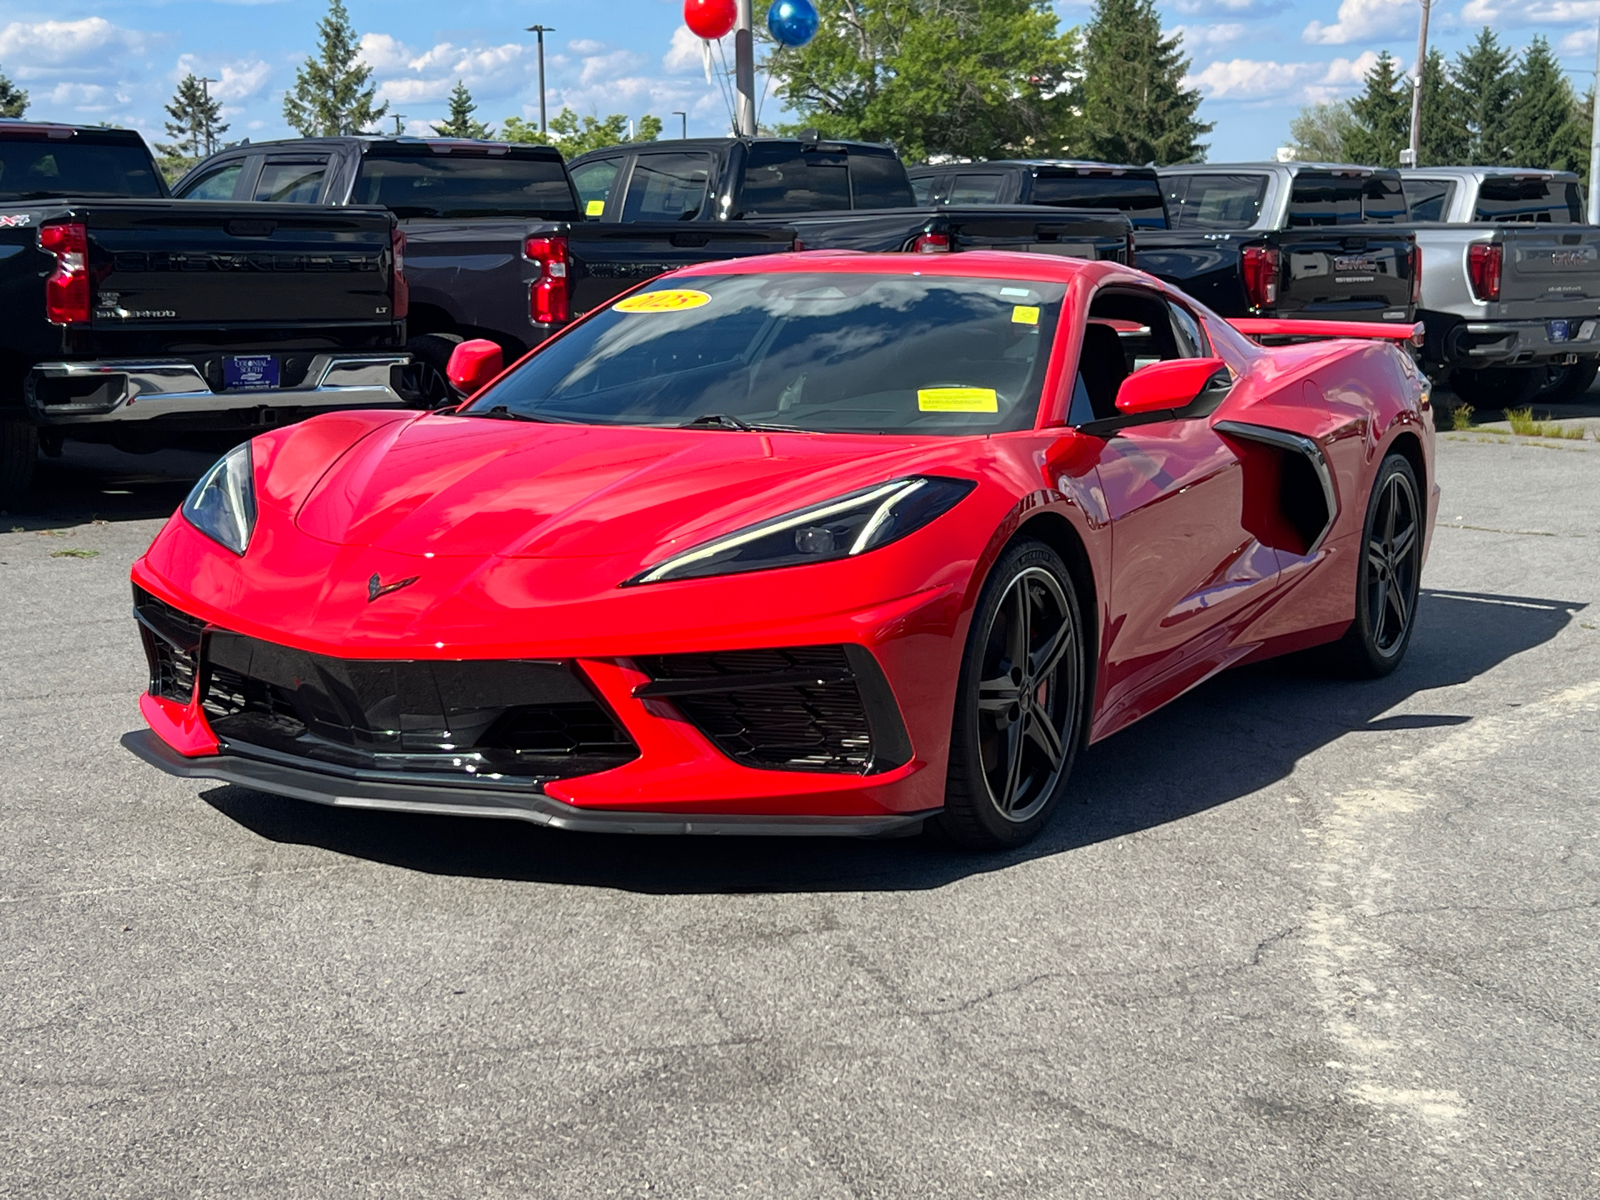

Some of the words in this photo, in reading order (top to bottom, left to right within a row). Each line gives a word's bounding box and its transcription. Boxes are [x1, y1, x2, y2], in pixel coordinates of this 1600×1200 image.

[114, 251, 381, 272] CHEVROLET
[1334, 255, 1376, 270] GMC
[622, 293, 701, 308] 2025
[96, 310, 176, 318] SILERADO
[375, 306, 388, 314] LT
